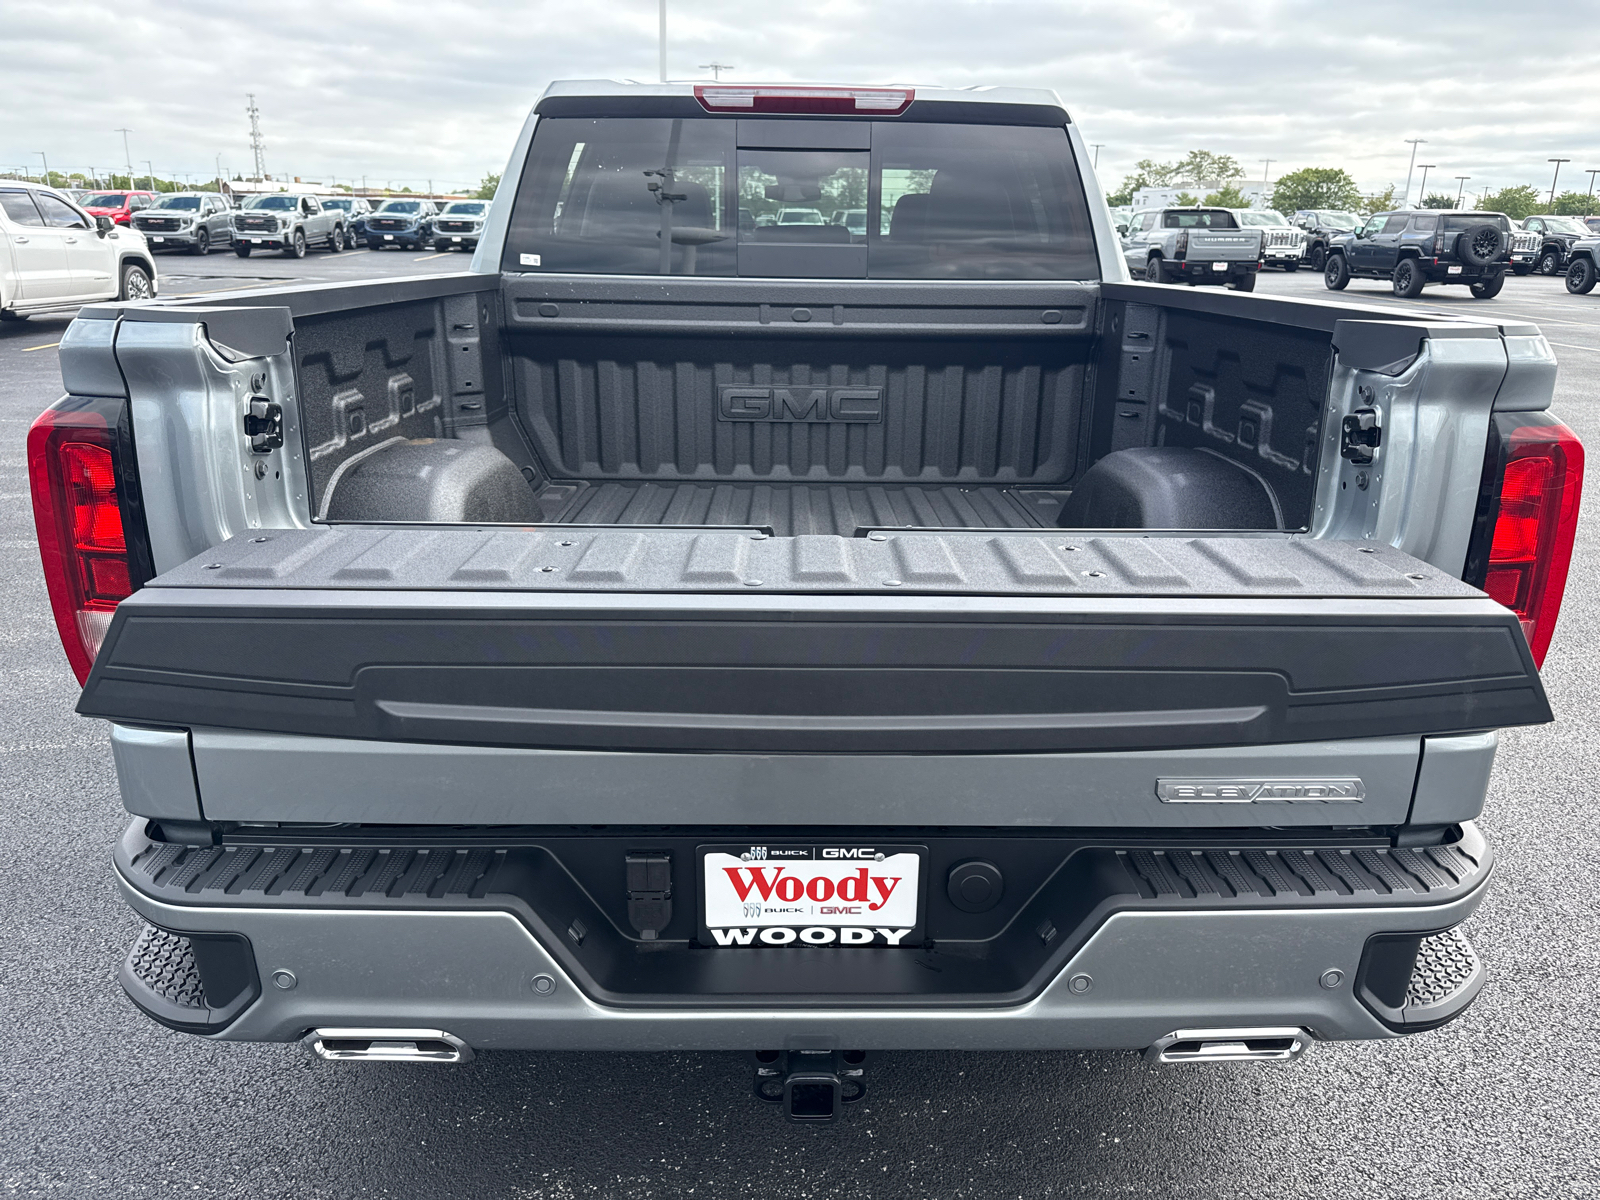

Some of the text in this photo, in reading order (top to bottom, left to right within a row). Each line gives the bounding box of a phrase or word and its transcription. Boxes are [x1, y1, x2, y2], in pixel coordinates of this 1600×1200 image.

[721, 388, 879, 420] GMC
[1173, 784, 1351, 798] ELEVATION
[822, 848, 876, 859] GMC
[721, 866, 903, 911] Woody
[820, 906, 862, 915] GMC
[710, 927, 912, 946] WOODY
